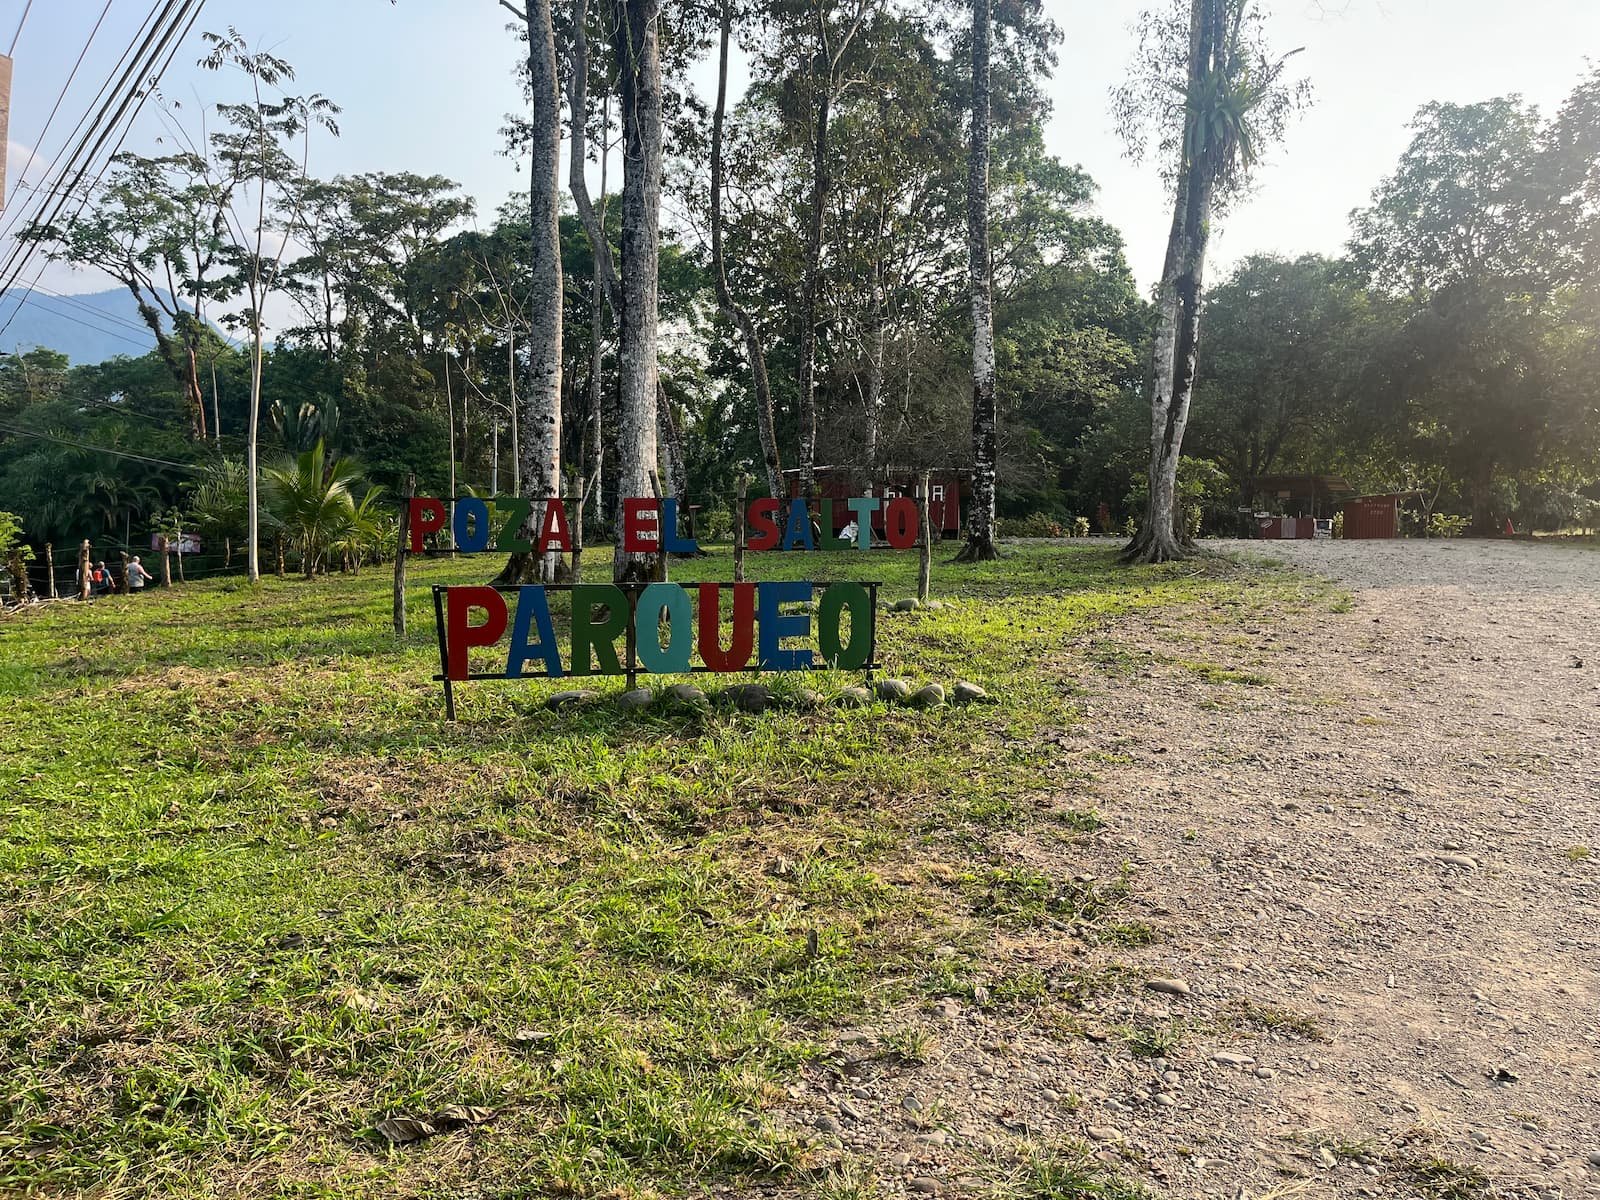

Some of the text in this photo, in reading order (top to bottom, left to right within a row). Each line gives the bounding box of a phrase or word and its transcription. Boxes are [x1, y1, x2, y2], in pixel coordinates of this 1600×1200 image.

[410, 497, 918, 553] POZA EL SALTO
[447, 582, 871, 681] PARQUEO
